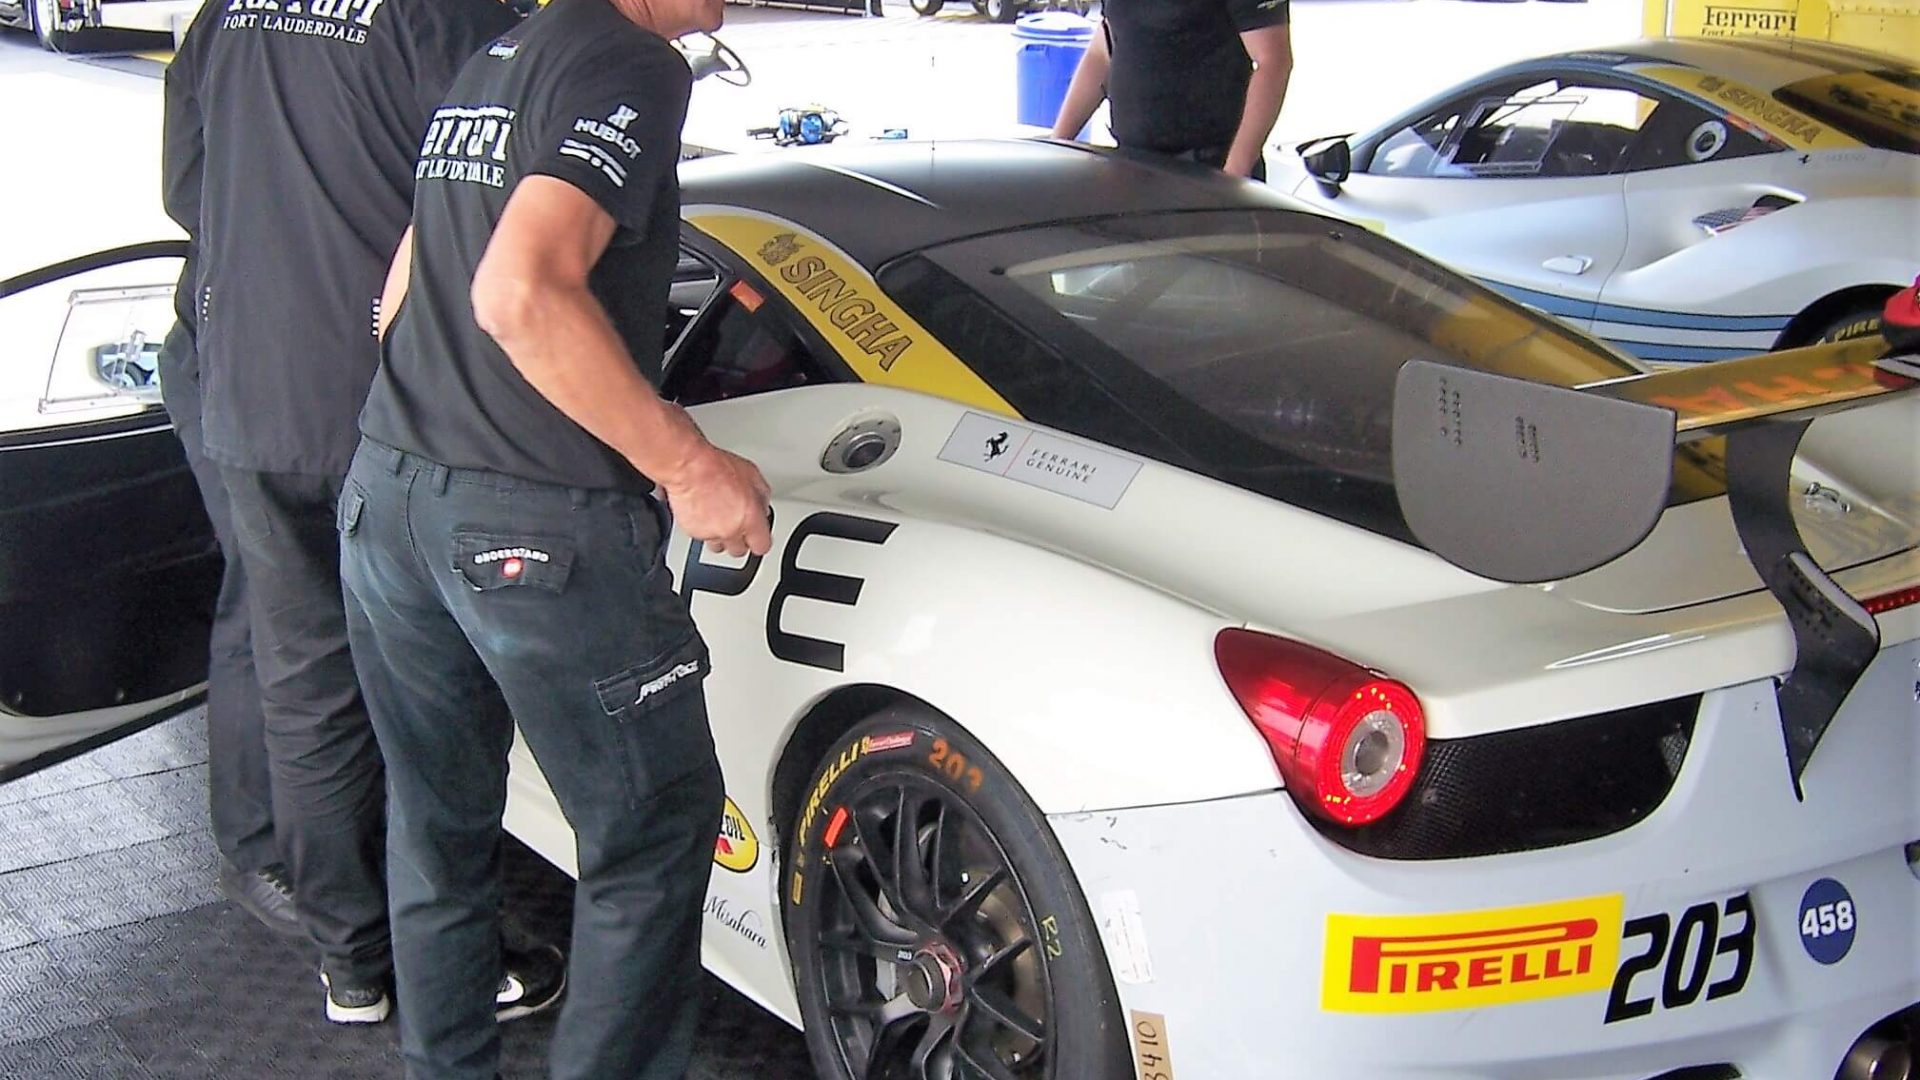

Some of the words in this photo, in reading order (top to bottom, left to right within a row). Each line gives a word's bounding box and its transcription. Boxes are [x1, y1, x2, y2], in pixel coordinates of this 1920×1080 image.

[262, 15, 369, 45] LAUDERDALE
[1703, 6, 1798, 31] Ferrari
[573, 118, 642, 160] HUBLOT
[780, 255, 913, 373] SINGHA
[1026, 458, 1090, 484] GENUINE
[1031, 449, 1097, 474] FERRARI
[799, 741, 861, 849] PIRELLI
[1801, 899, 1855, 938] 458
[1348, 917, 1599, 995] PIRELLI
[1603, 891, 1758, 1025] 203
